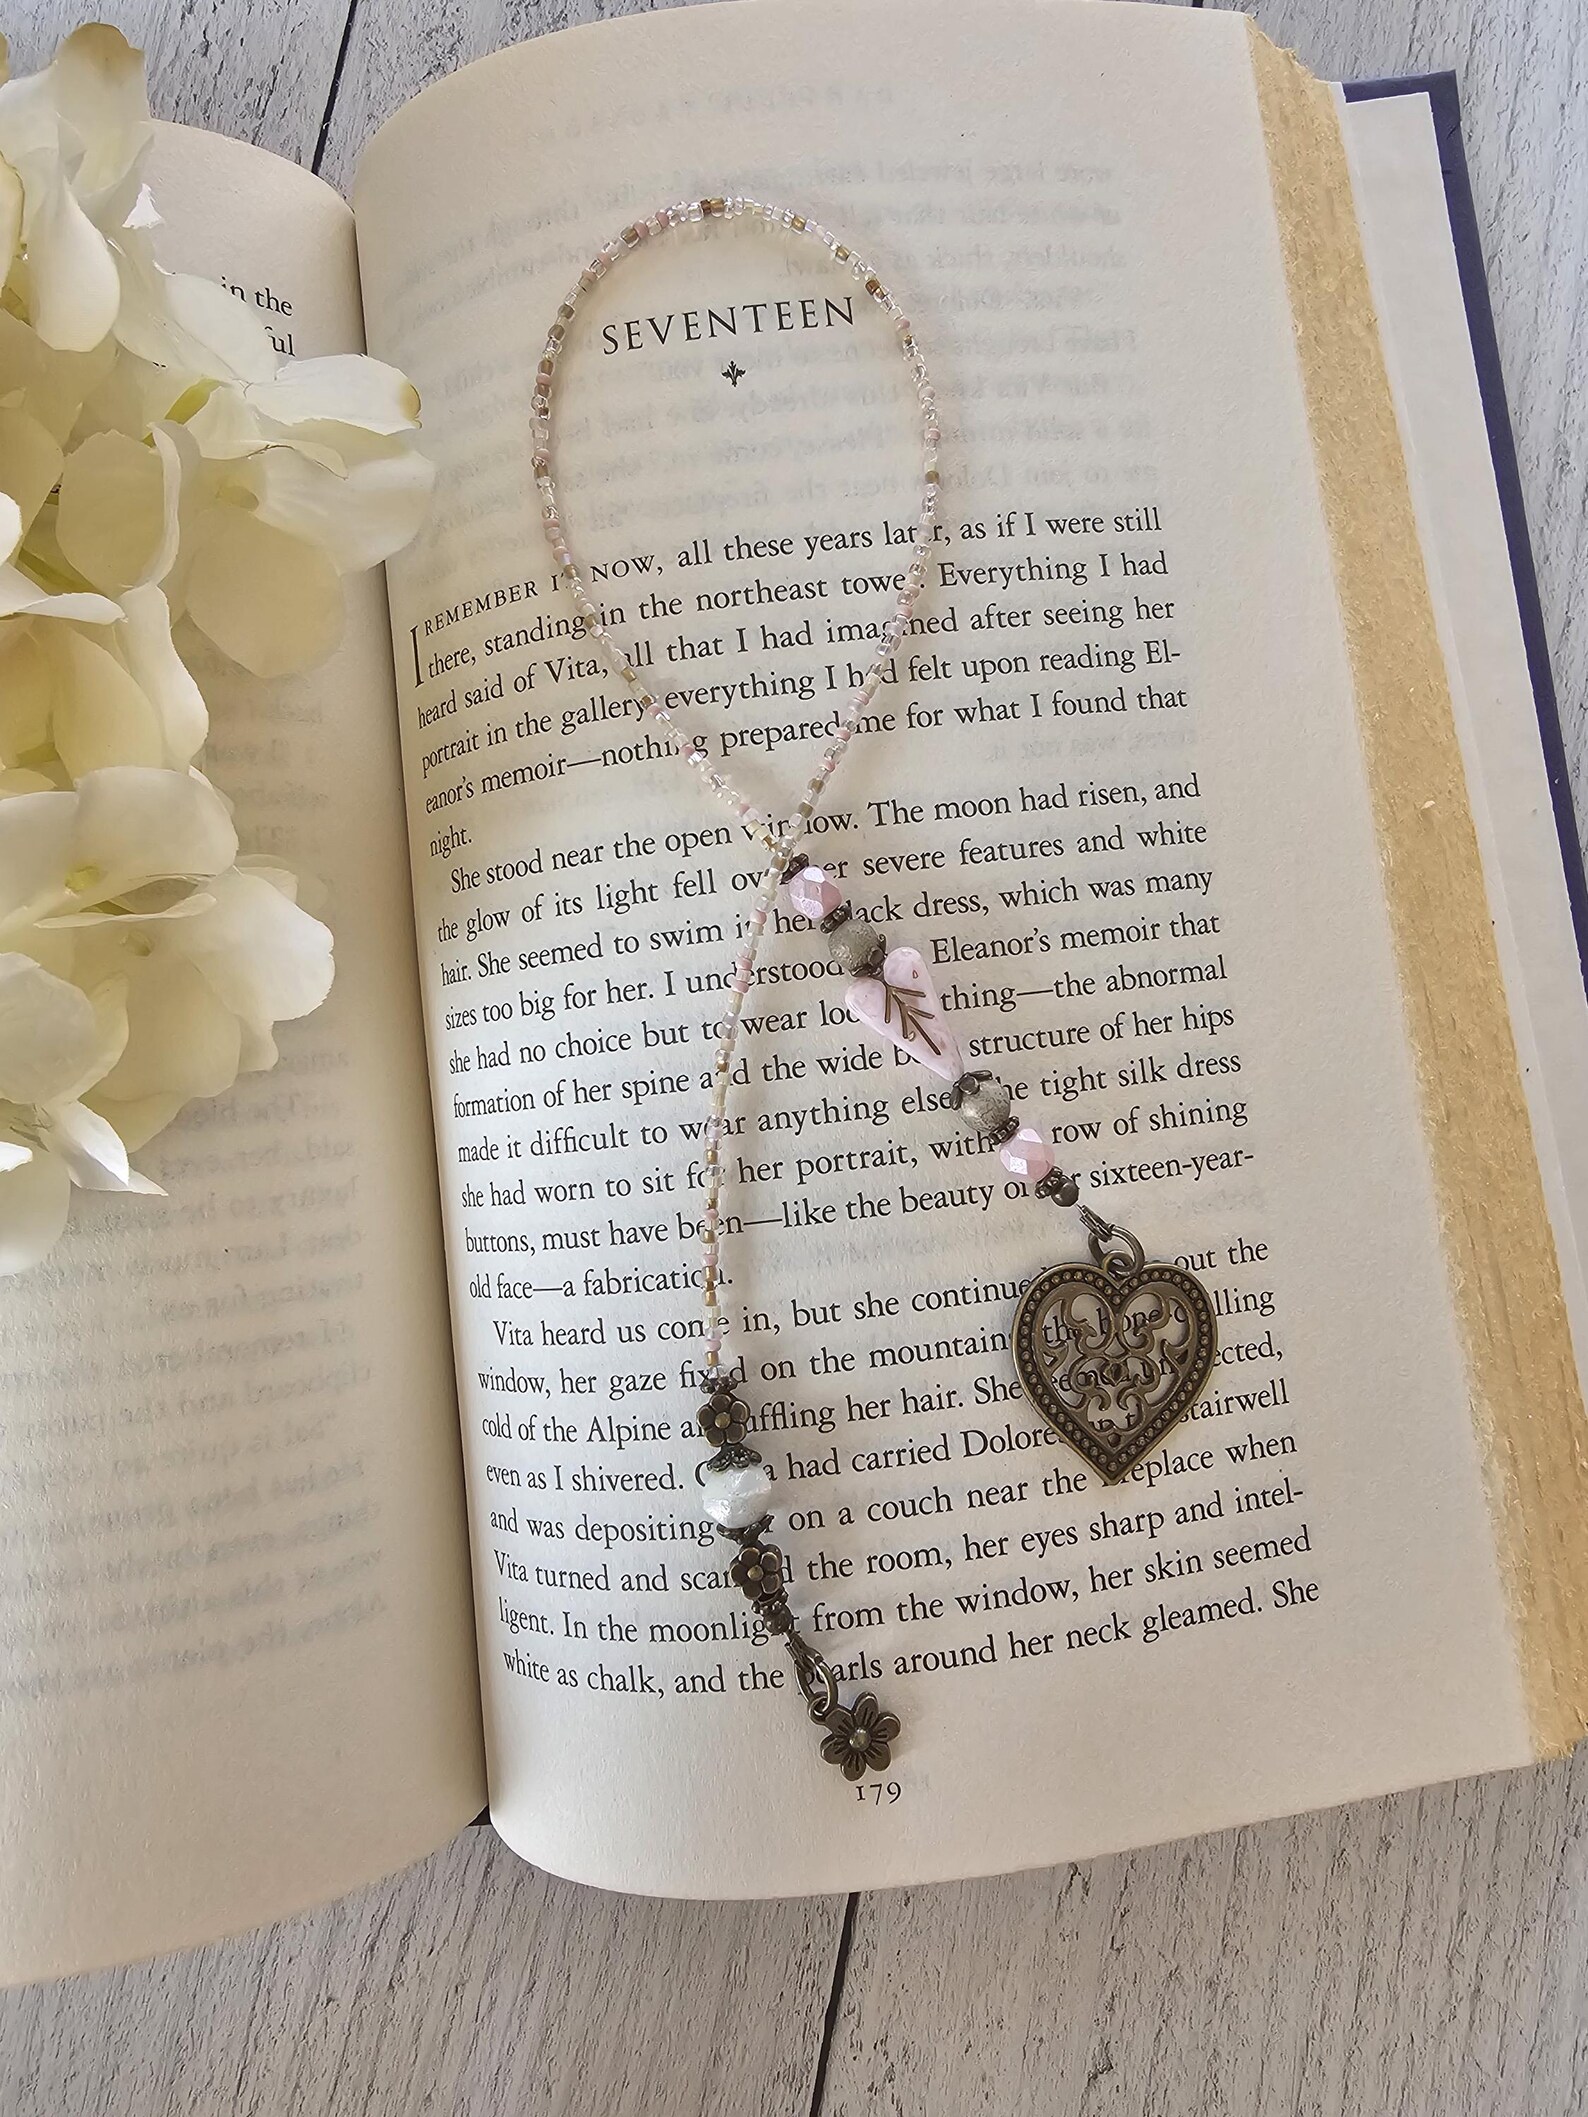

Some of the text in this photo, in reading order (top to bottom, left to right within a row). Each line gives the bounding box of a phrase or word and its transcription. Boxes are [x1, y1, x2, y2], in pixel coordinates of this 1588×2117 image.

[254, 287, 293, 316] the
[265, 326, 296, 357] ul
[602, 296, 854, 355] SEVENTEEN
[424, 506, 1163, 637] REMEMBER NOW, all these years were still
[428, 549, 1169, 679] there, standing the northeast Everything had
[417, 595, 1175, 730] heard said Vita, that had after seeing her
[421, 638, 1181, 780] portrait the everything felt upon reading El-
[905, 701, 944, 729] for
[952, 696, 1022, 724] what
[1051, 686, 1128, 717] found
[1136, 684, 1188, 711] that
[429, 824, 472, 859] night.
[450, 771, 1202, 894] She stood near the open The moon had risen, and
[466, 820, 1208, 943] glow light fell severe features and white
[440, 871, 1213, 987] hair. She seemed swim dress, which was many
[445, 1005, 478, 1031] sizes
[482, 1002, 514, 1023] too
[518, 989, 556, 1022] big
[563, 982, 598, 1011] for
[604, 978, 654, 1005] her.
[1059, 916, 1161, 950] memoir
[1168, 911, 1221, 938] that
[449, 953, 1228, 1075] she had choice but wear abnormal
[453, 1003, 1235, 1119] formation her spine wide structure her hips
[457, 1051, 1242, 1163] made difficult anything tight silk dress
[461, 1098, 1249, 1208] she had worn sit her portrait, row shining
[464, 1149, 1255, 1257] buttons, must have beauty sixteen-year-
[469, 1272, 493, 1299] old
[492, 1290, 900, 1347] Vita heard but she
[477, 1366, 667, 1402] window, her gaze
[482, 1374, 1021, 1451] cold Alpine her hair. She
[486, 1432, 952, 1493] even shivered. had carried
[490, 1432, 1298, 1550] and was depositing couch near when
[493, 1476, 1304, 1592] Vita turned and room, her eyes sharp and intel-
[498, 1523, 1313, 1636] ligent. from window, her skin seemed
[502, 1577, 1320, 1700] white chalk, and around her neck gleamed. She
[855, 1781, 902, 1806] 179
